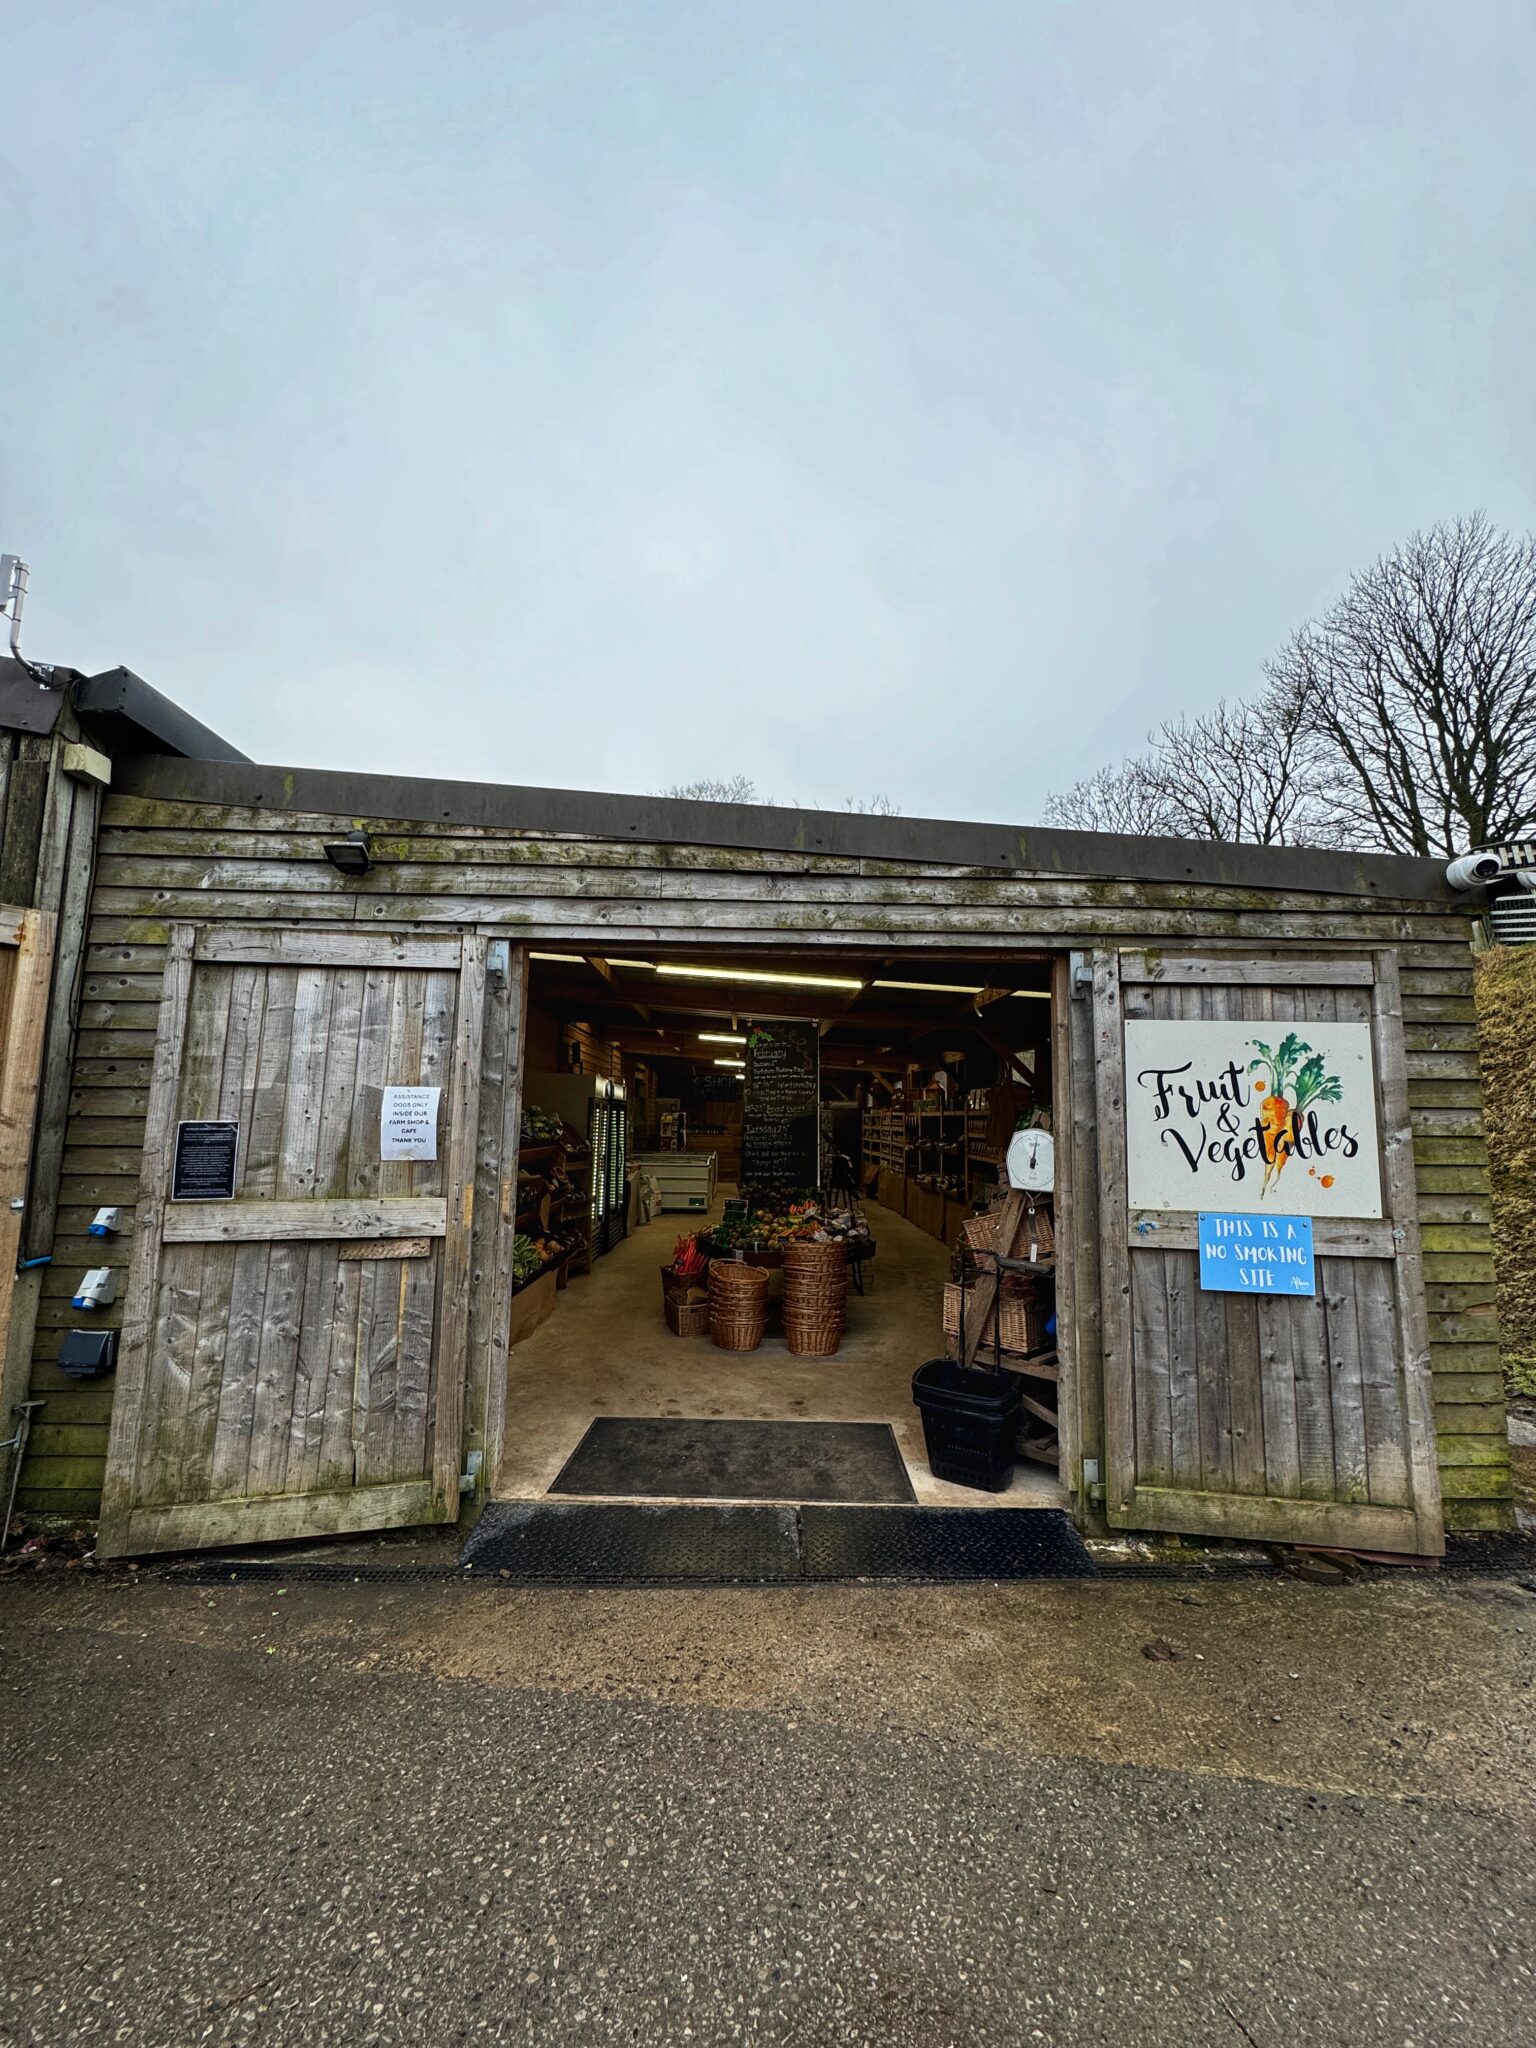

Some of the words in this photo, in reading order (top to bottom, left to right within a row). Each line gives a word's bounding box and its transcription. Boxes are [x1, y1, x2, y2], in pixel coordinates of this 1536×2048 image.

[704, 1075, 735, 1088] SHOP
[1137, 1061, 1250, 1122] Fruit
[1216, 1102, 1241, 1137] &
[1160, 1110, 1360, 1182] Vegetables
[1213, 1218, 1253, 1238] THIS
[1262, 1220, 1279, 1238] IS
[1287, 1223, 1297, 1240] A
[1205, 1243, 1227, 1260] NO
[1234, 1243, 1308, 1265] SMOKING
[1239, 1267, 1275, 1287] SITE
